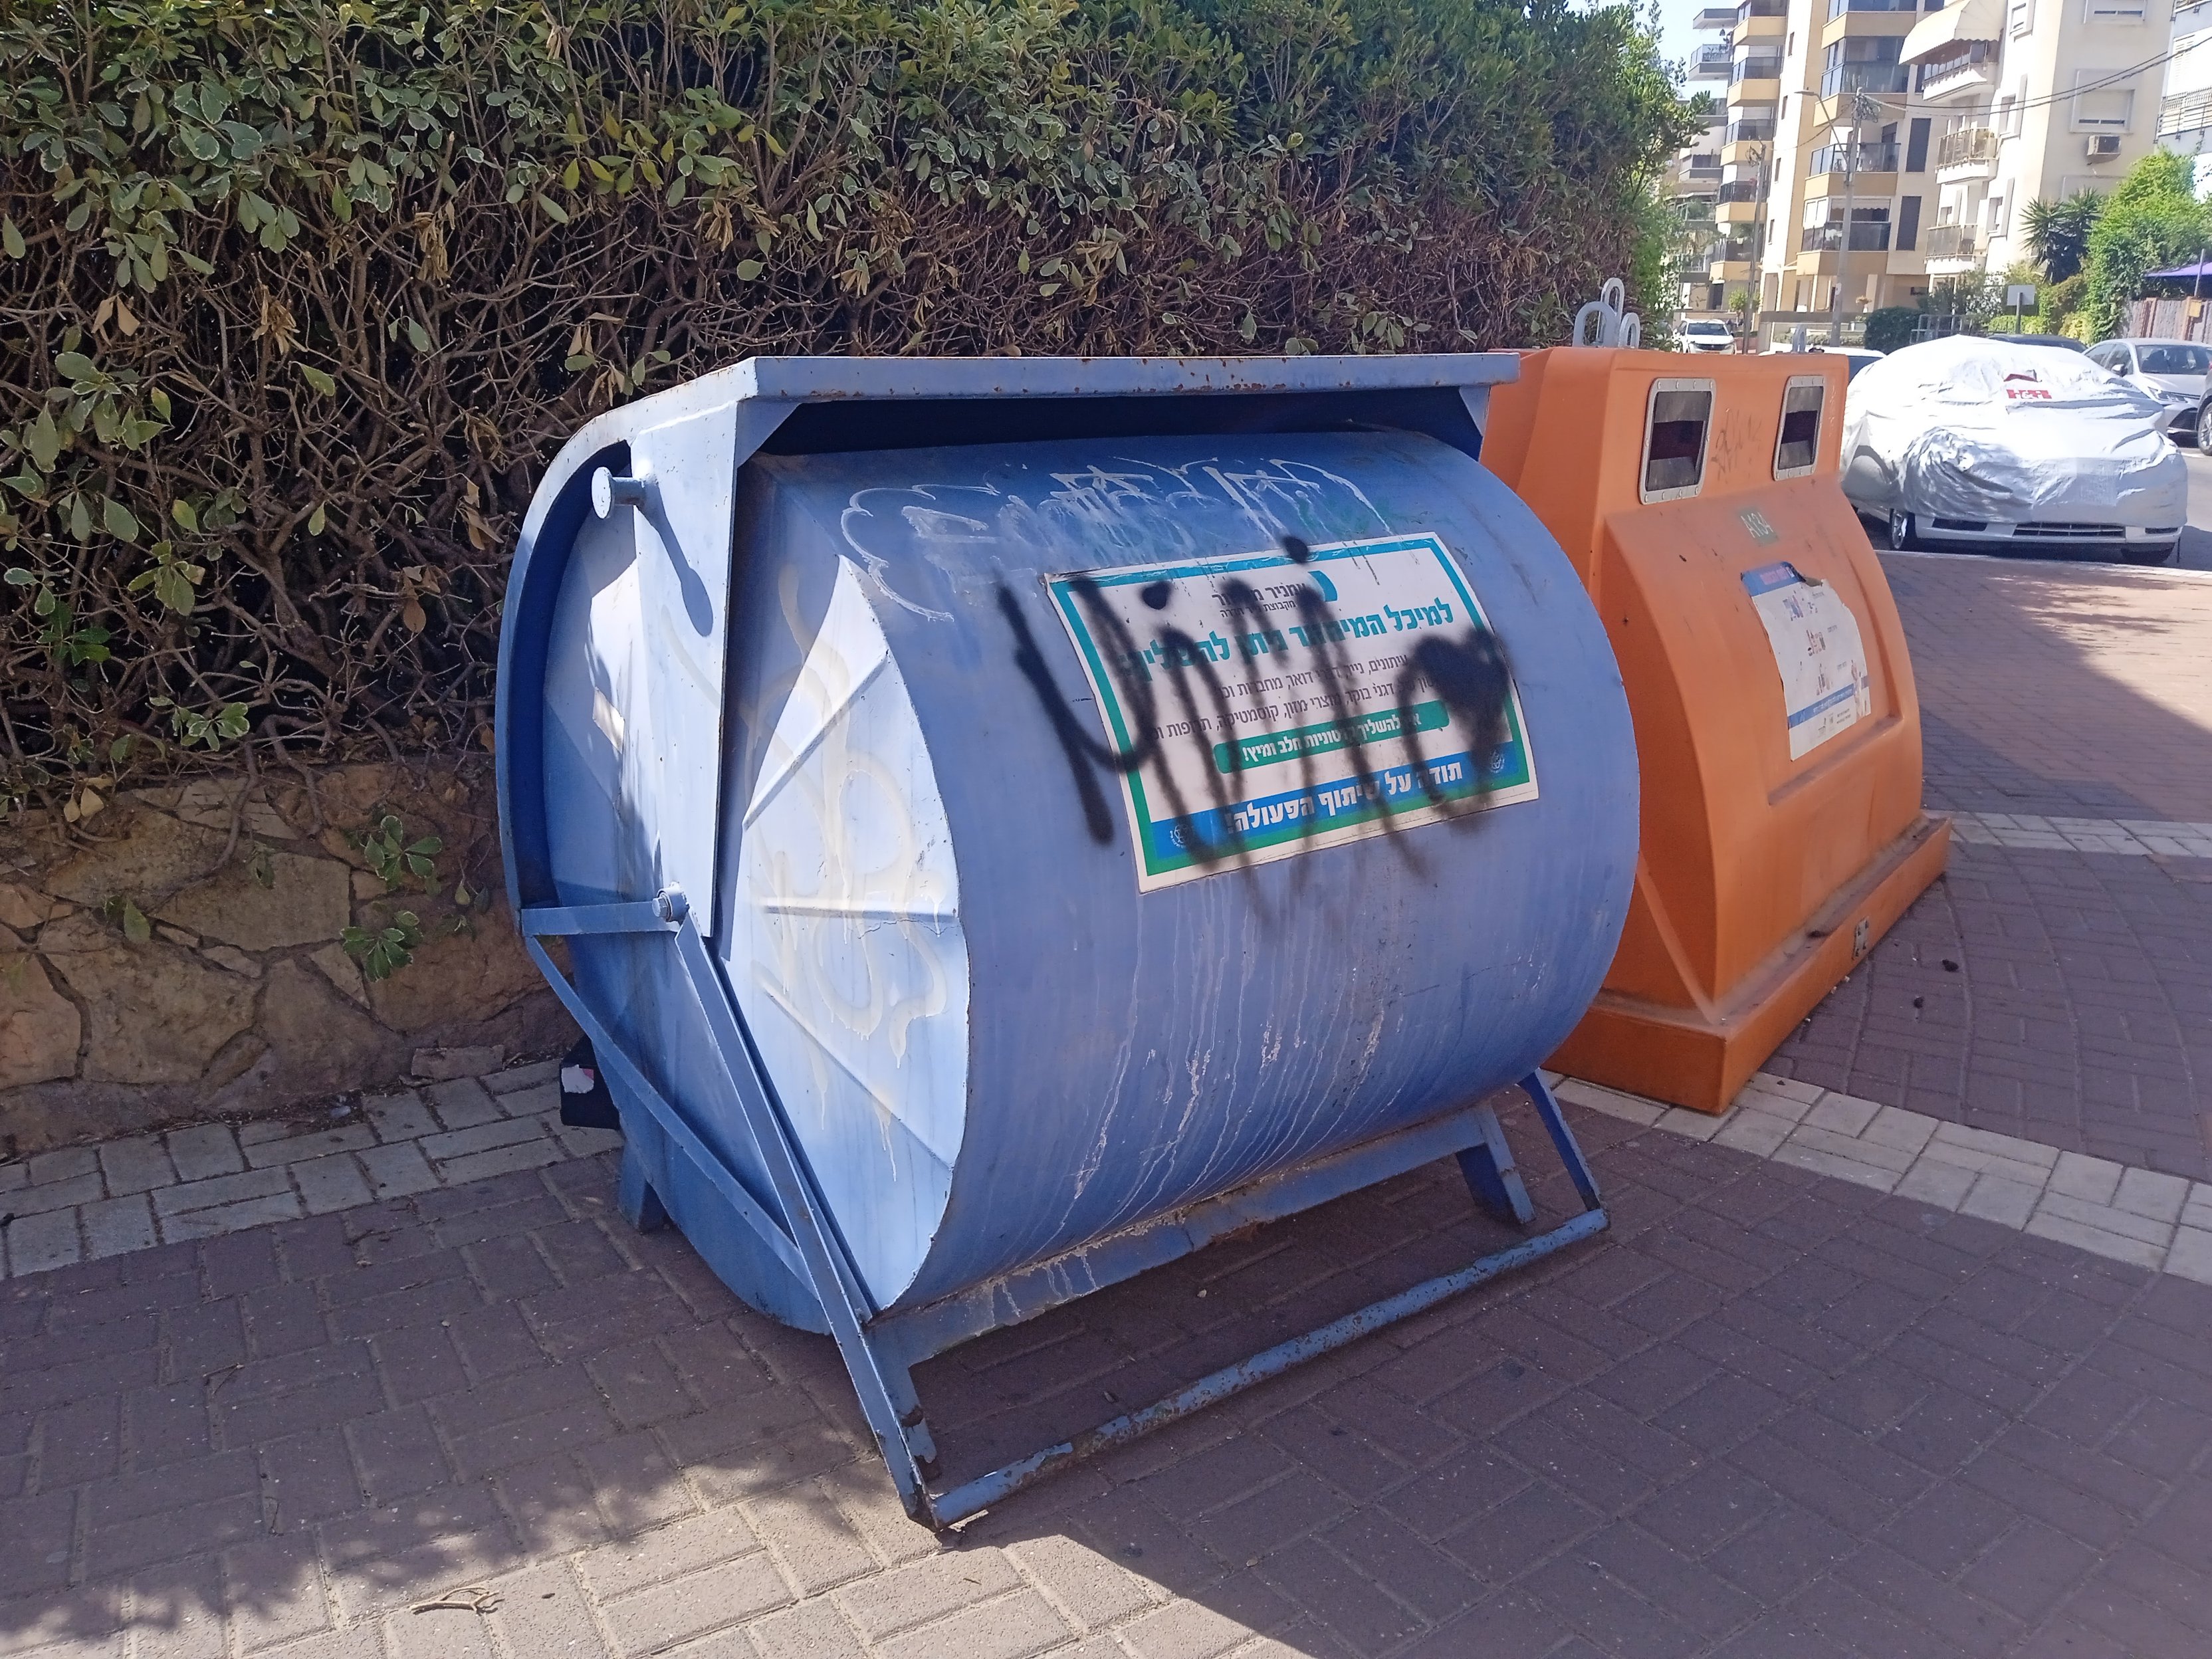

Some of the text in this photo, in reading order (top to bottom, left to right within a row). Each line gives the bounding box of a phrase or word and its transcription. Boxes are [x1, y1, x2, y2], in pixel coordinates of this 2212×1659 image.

[1263, 600, 1296, 612] מקבוצת
[1383, 597, 1454, 631] למיכל
[1234, 629, 1289, 665] ניתן
[1237, 676, 1283, 696] מחברות
[1285, 671, 1314, 691] דואר,
[1372, 683, 1395, 697] דגני
[1310, 693, 1342, 709] מוצרי
[1345, 687, 1373, 706] בוקר,
[1216, 705, 1279, 731] קוסמטיקה,
[1357, 713, 1401, 740] להשליך
[1242, 742, 1277, 762] ומיץ!
[1279, 735, 1303, 754] חלב
[1227, 762, 1463, 833] תודה על שיתוף הפעולה!
